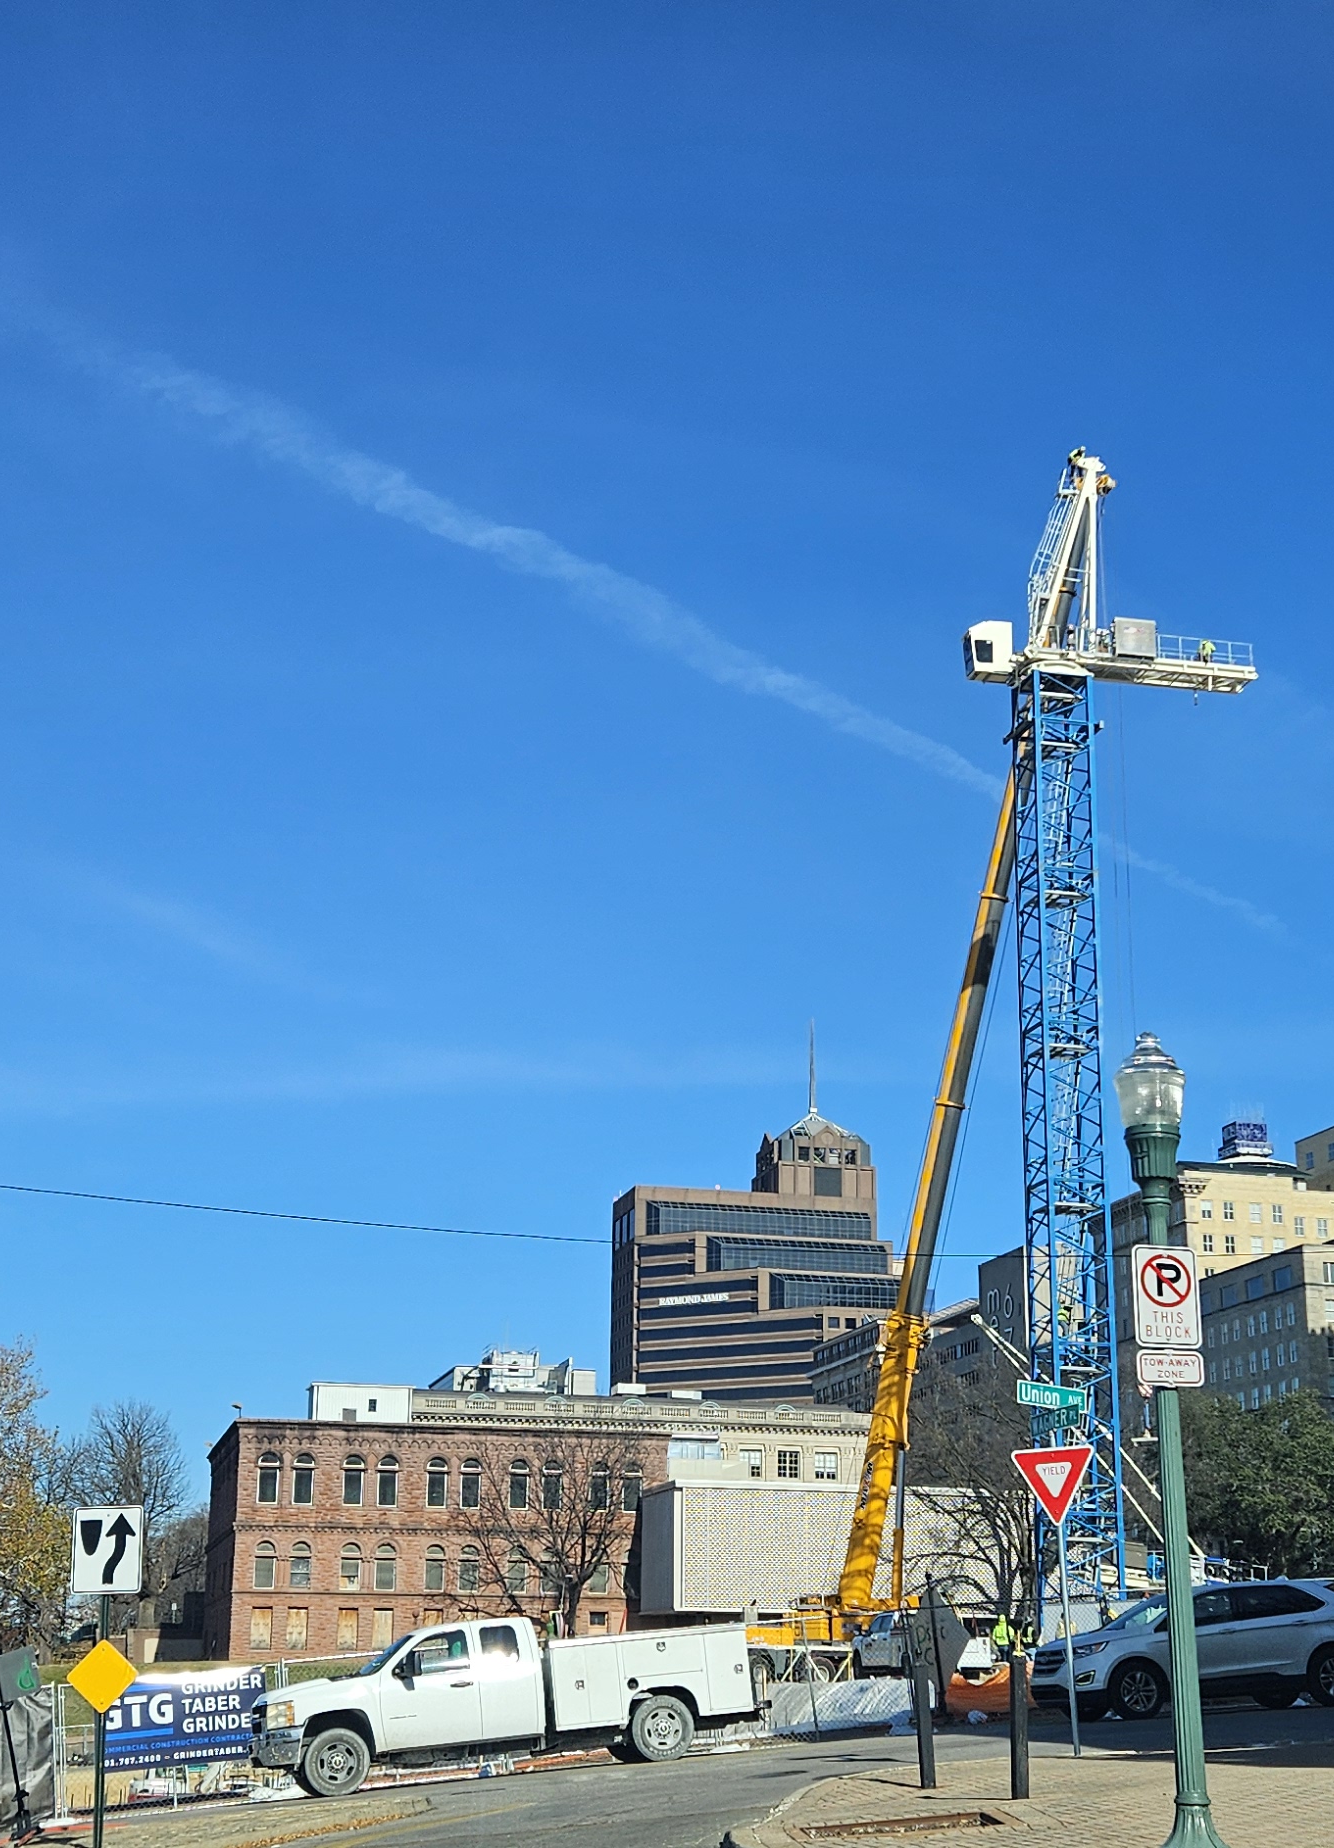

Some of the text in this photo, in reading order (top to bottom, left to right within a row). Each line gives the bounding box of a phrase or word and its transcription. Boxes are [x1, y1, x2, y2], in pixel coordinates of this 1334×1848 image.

[658, 1291, 730, 1307] RAYMOND JAMES
[1152, 1310, 1184, 1324] THIS
[1145, 1324, 1192, 1339] BLOCK
[1142, 1357, 1197, 1368] TOW-AWAY
[1157, 1369, 1186, 1379] ZONE
[1021, 1383, 1083, 1407] Union AVE
[1069, 1410, 1077, 1421] PL
[1042, 1465, 1066, 1476] YIELD
[181, 1673, 263, 1695] GRINDER
[104, 1692, 174, 1731] GTG
[180, 1694, 242, 1715] TABER
[104, 1743, 149, 1755] OMMERCIAL
[150, 1738, 209, 1750] CONSTRUCTION
